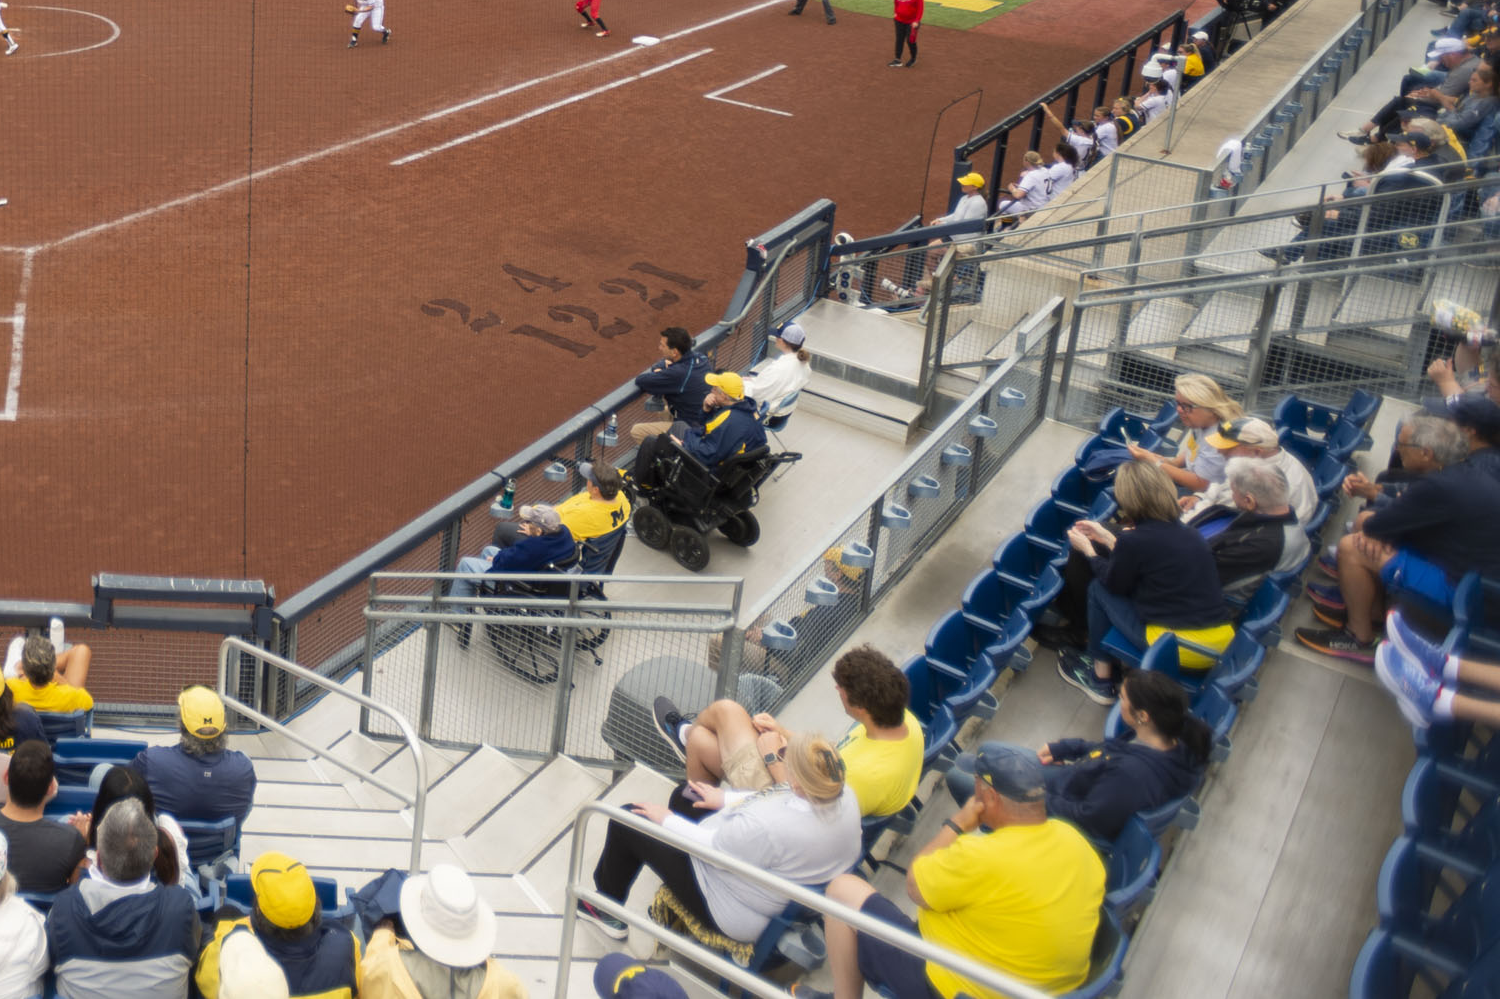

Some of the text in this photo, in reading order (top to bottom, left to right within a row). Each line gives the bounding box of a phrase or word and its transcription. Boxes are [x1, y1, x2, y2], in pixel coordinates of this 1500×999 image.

[610, 505, 624, 528] M
[1330, 640, 1359, 651] HOKA
[204, 717, 213, 725] M
